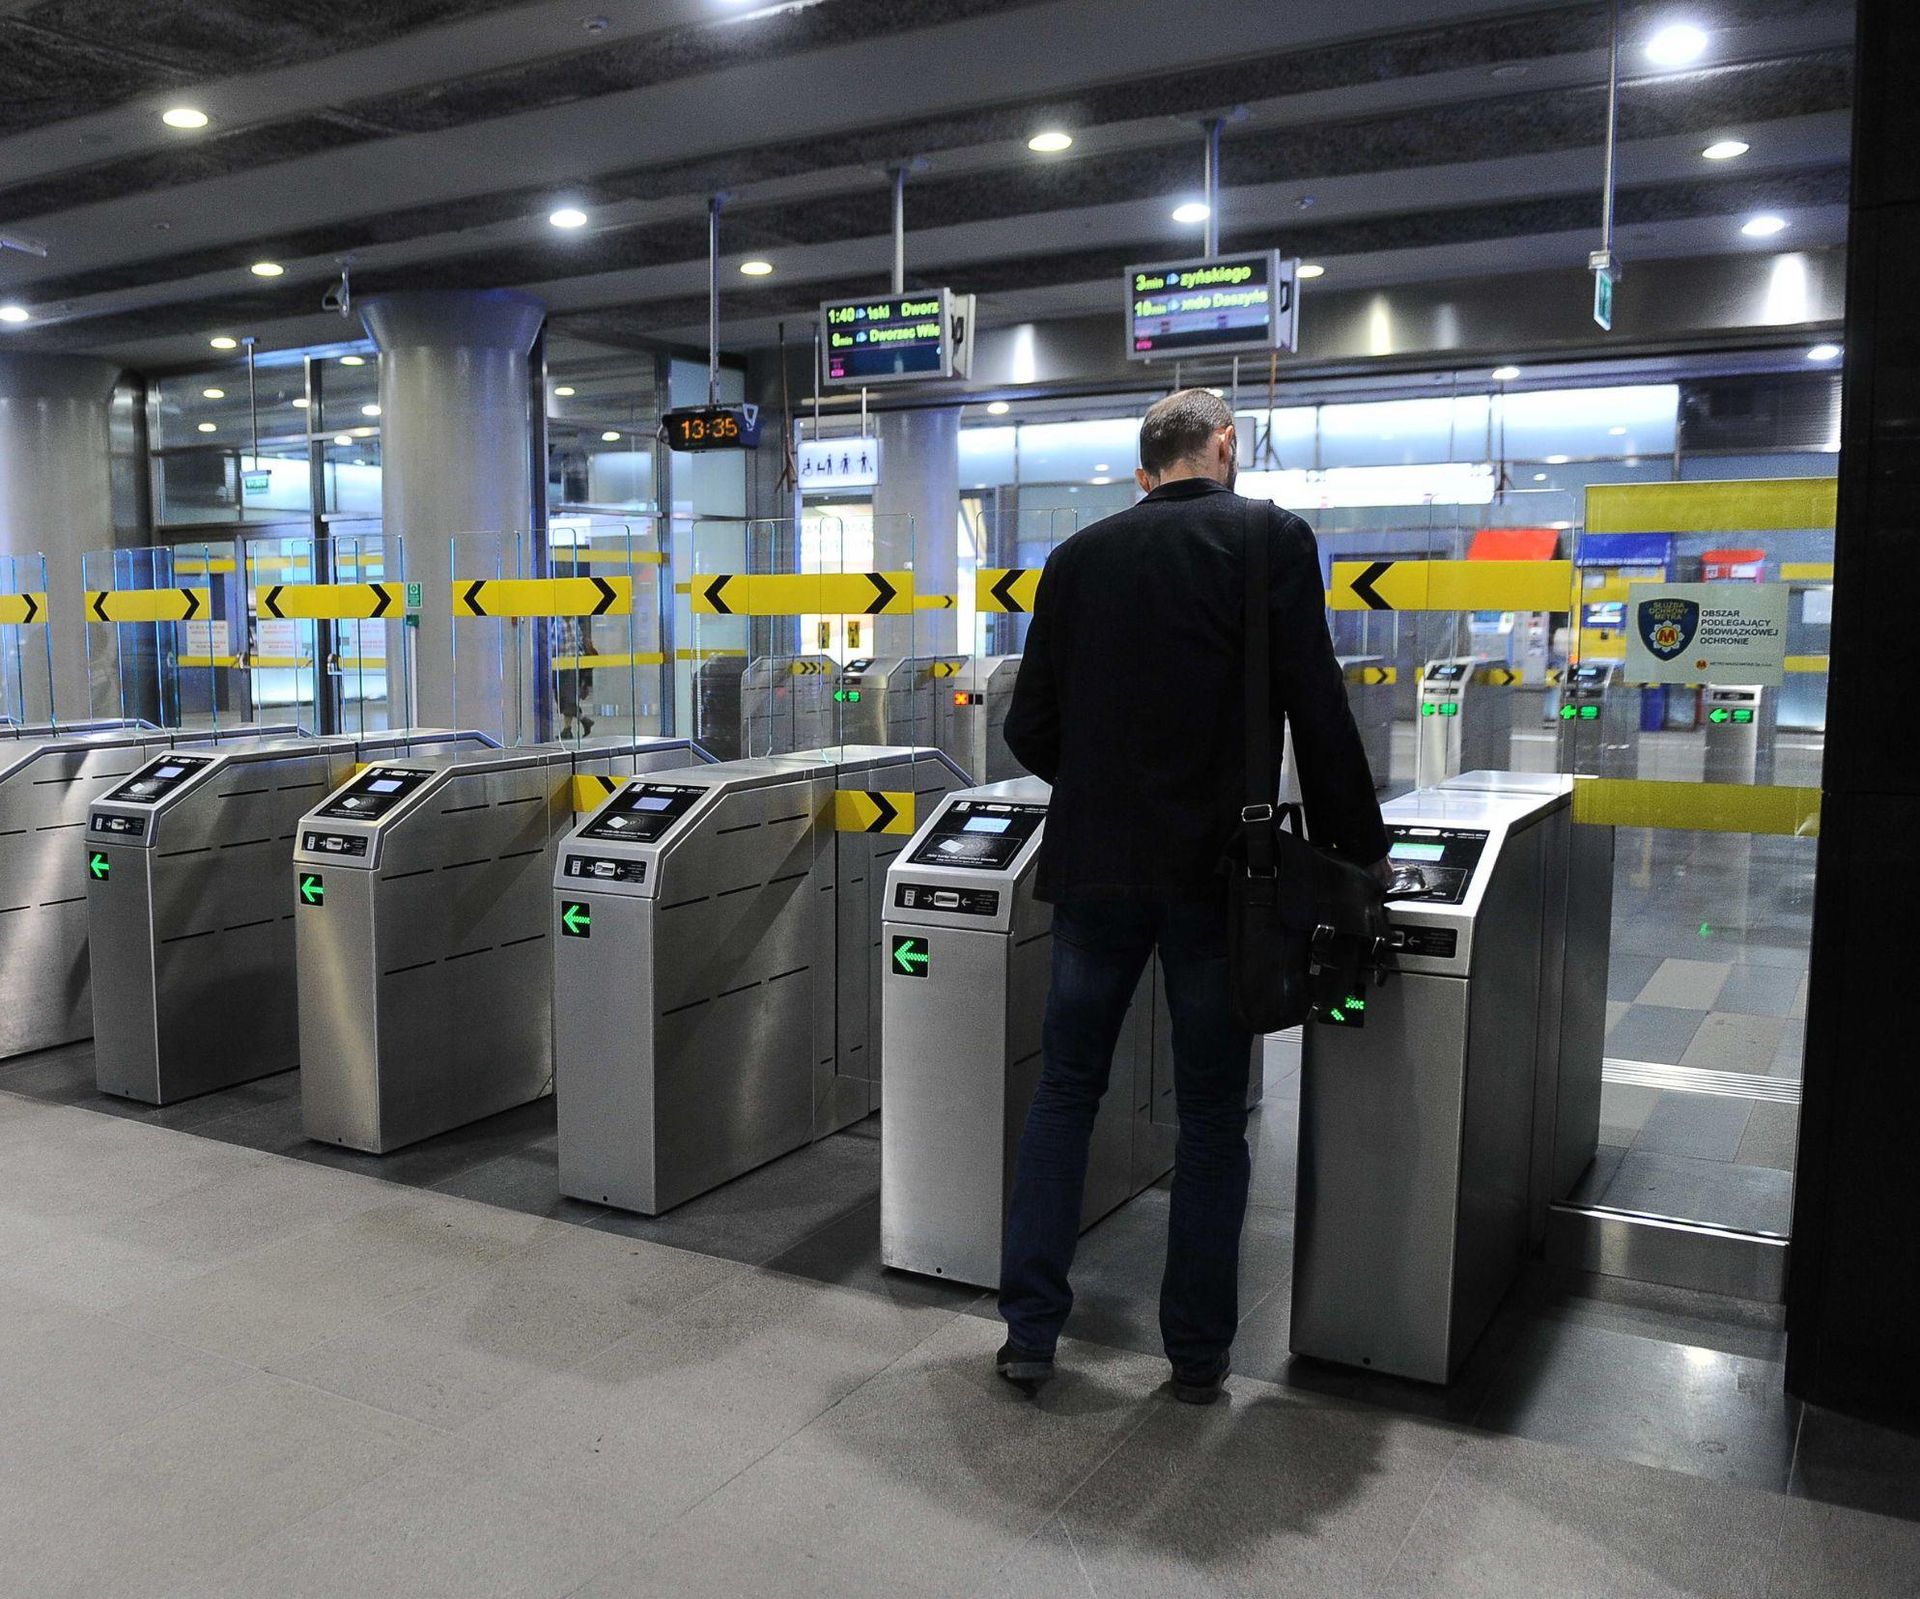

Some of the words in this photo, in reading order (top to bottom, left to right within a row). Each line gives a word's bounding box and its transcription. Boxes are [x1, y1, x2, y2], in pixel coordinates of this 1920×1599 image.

[829, 306, 855, 323] 1:40
[681, 418, 738, 440] 13:35
[1701, 609, 1740, 617] OBSZAR
[1701, 619, 1771, 628] PODLEGAJĄCY
[1700, 628, 1779, 637] OBOWIĄZKOWEJ
[1700, 637, 1749, 645] OCHRONIE
